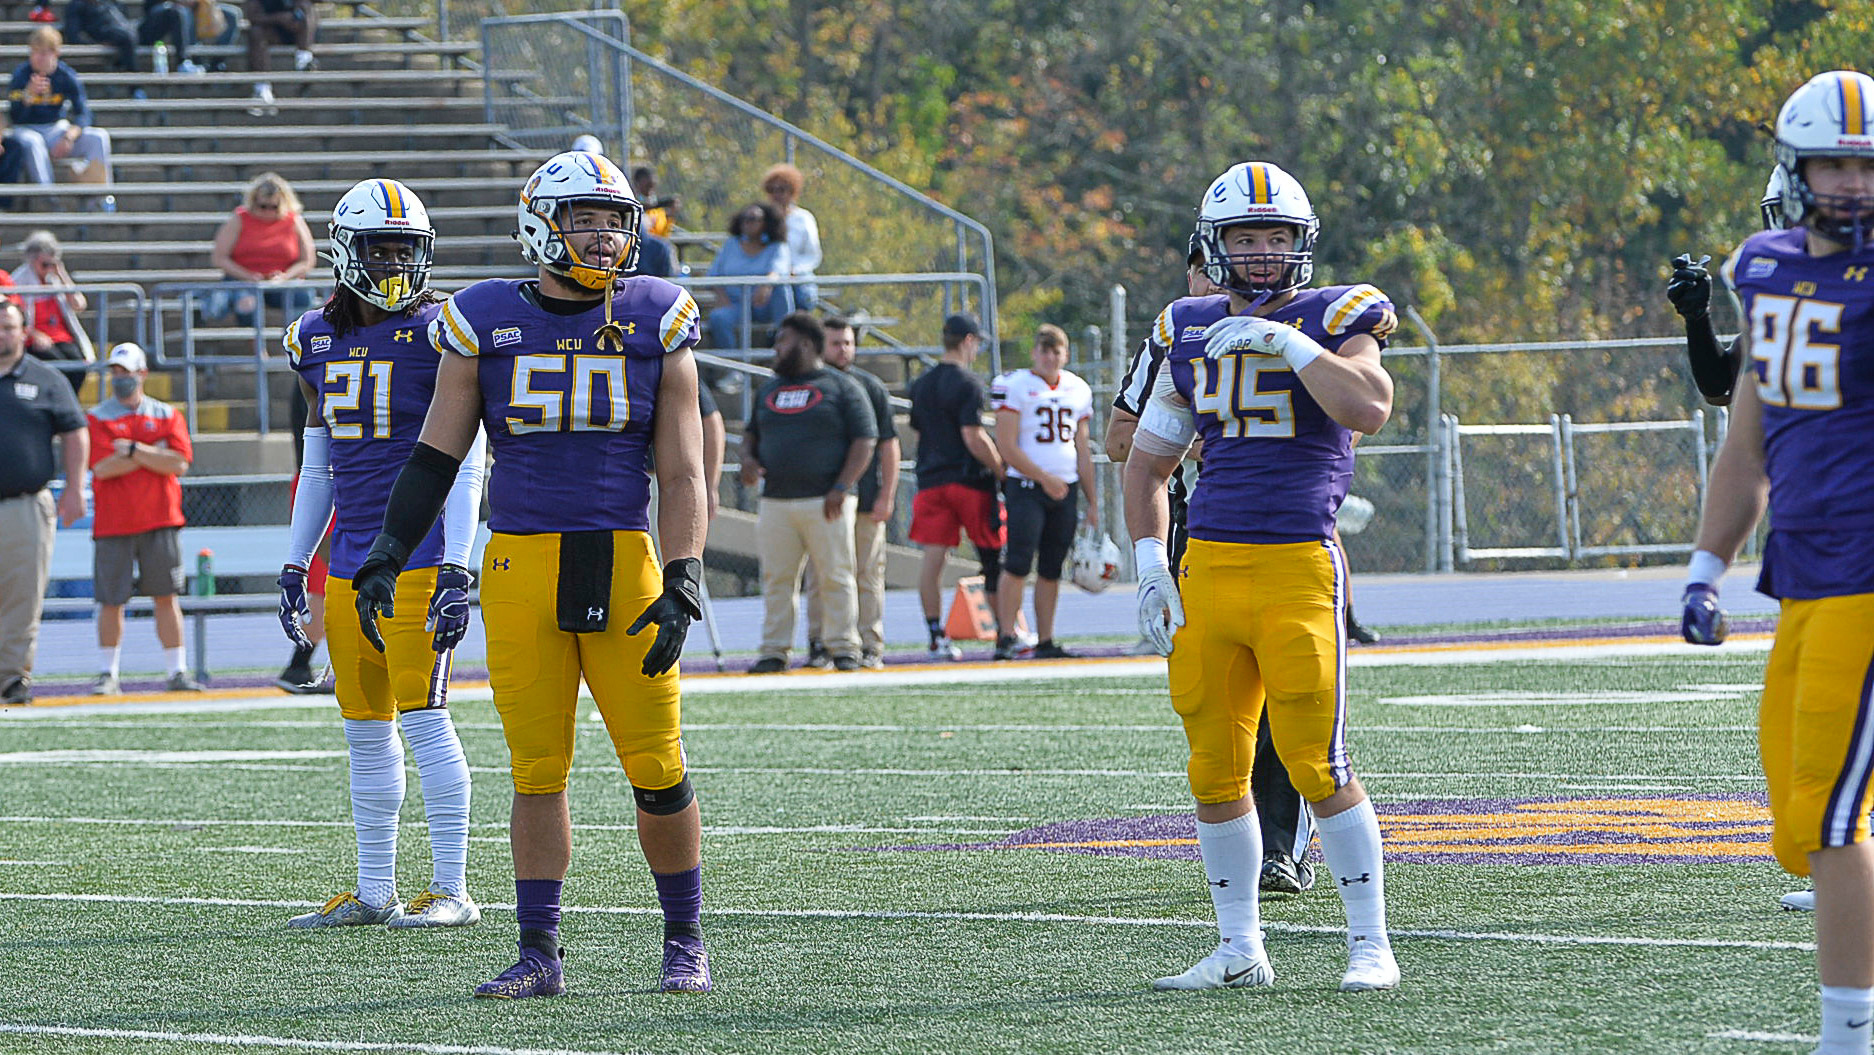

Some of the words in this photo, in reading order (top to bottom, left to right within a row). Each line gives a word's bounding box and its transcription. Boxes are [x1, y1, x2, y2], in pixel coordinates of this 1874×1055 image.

[349, 347, 368, 358] WCU
[494, 330, 520, 343] PSAC
[556, 338, 582, 351] WCU
[1751, 293, 1845, 411] 96
[323, 360, 394, 439] 21
[505, 353, 631, 436] 50
[1189, 353, 1296, 438] 45
[1035, 406, 1073, 443] 36
